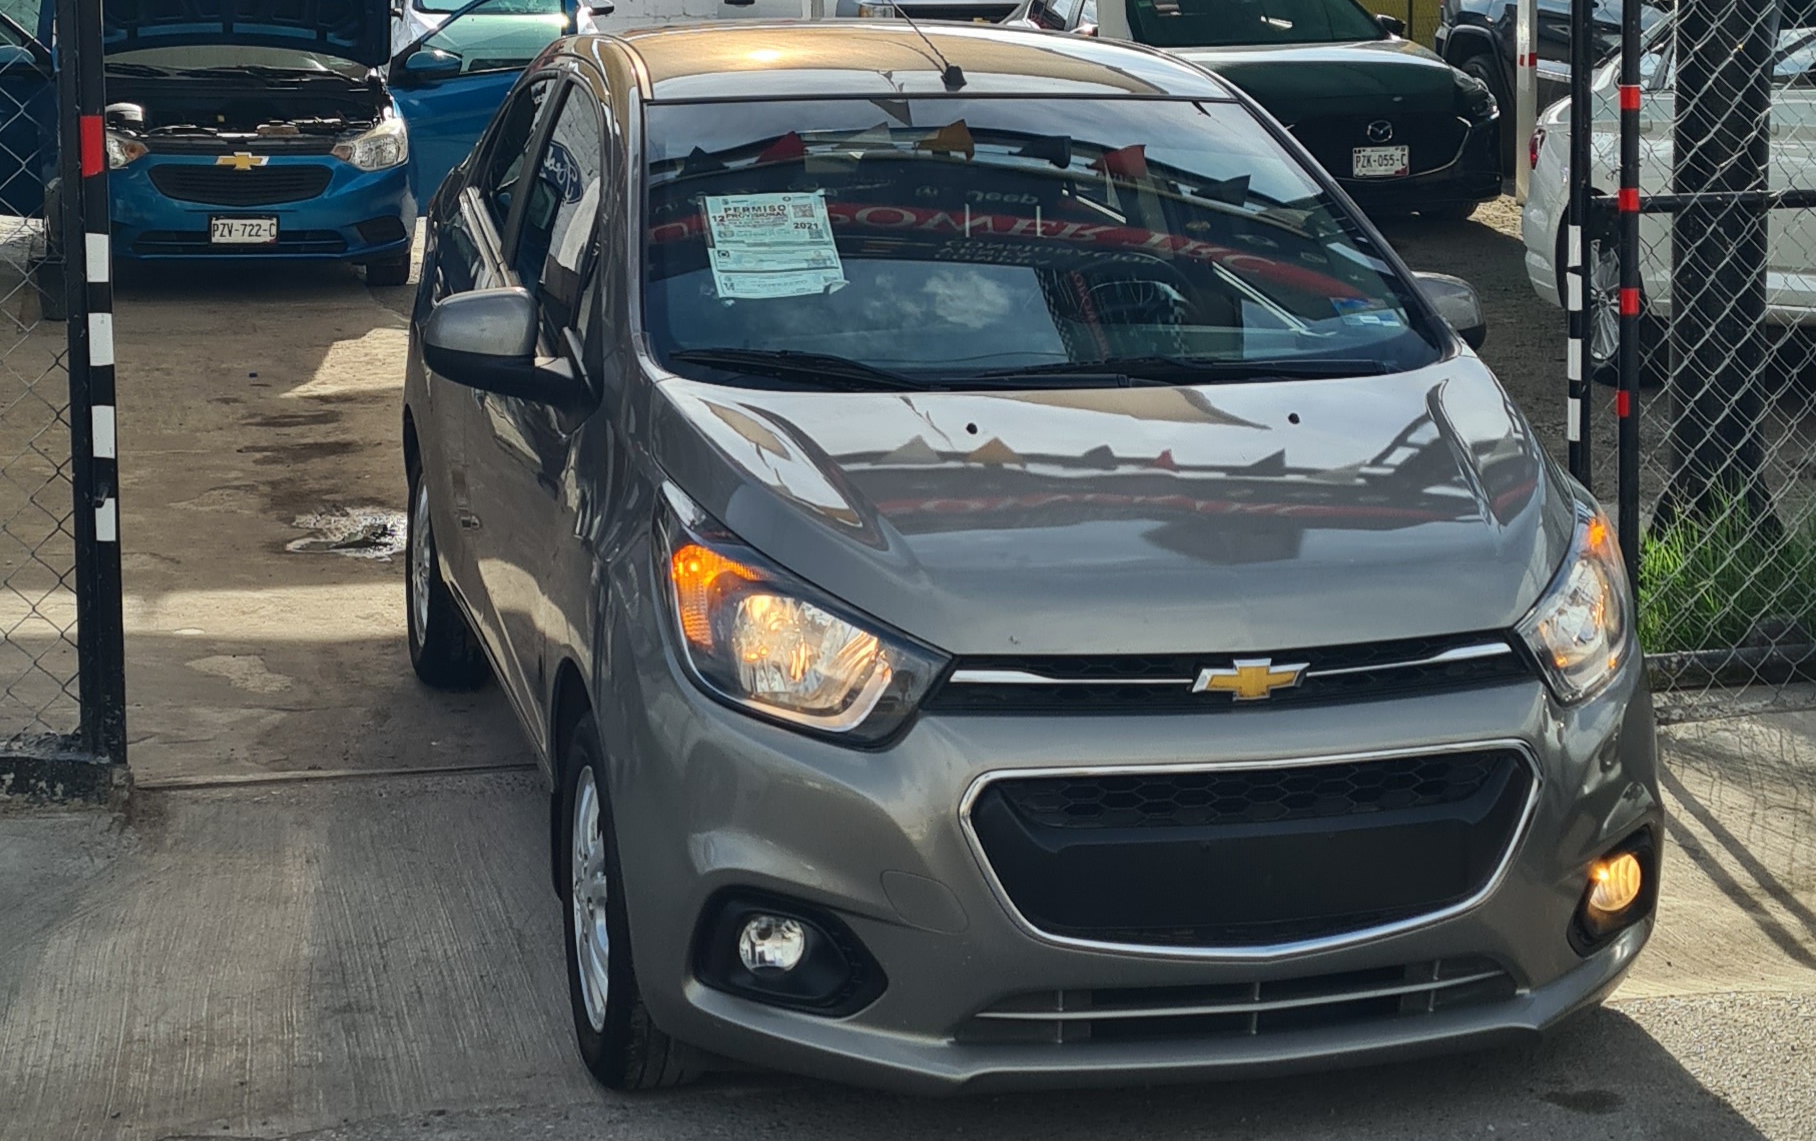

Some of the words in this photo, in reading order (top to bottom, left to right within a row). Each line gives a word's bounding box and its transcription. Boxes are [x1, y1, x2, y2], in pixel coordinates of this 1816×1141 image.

[1355, 153, 1407, 169] PZK-055-C
[723, 204, 787, 214] PERMISO
[212, 222, 277, 238] PZV-722-C
[793, 222, 819, 230] 2021
